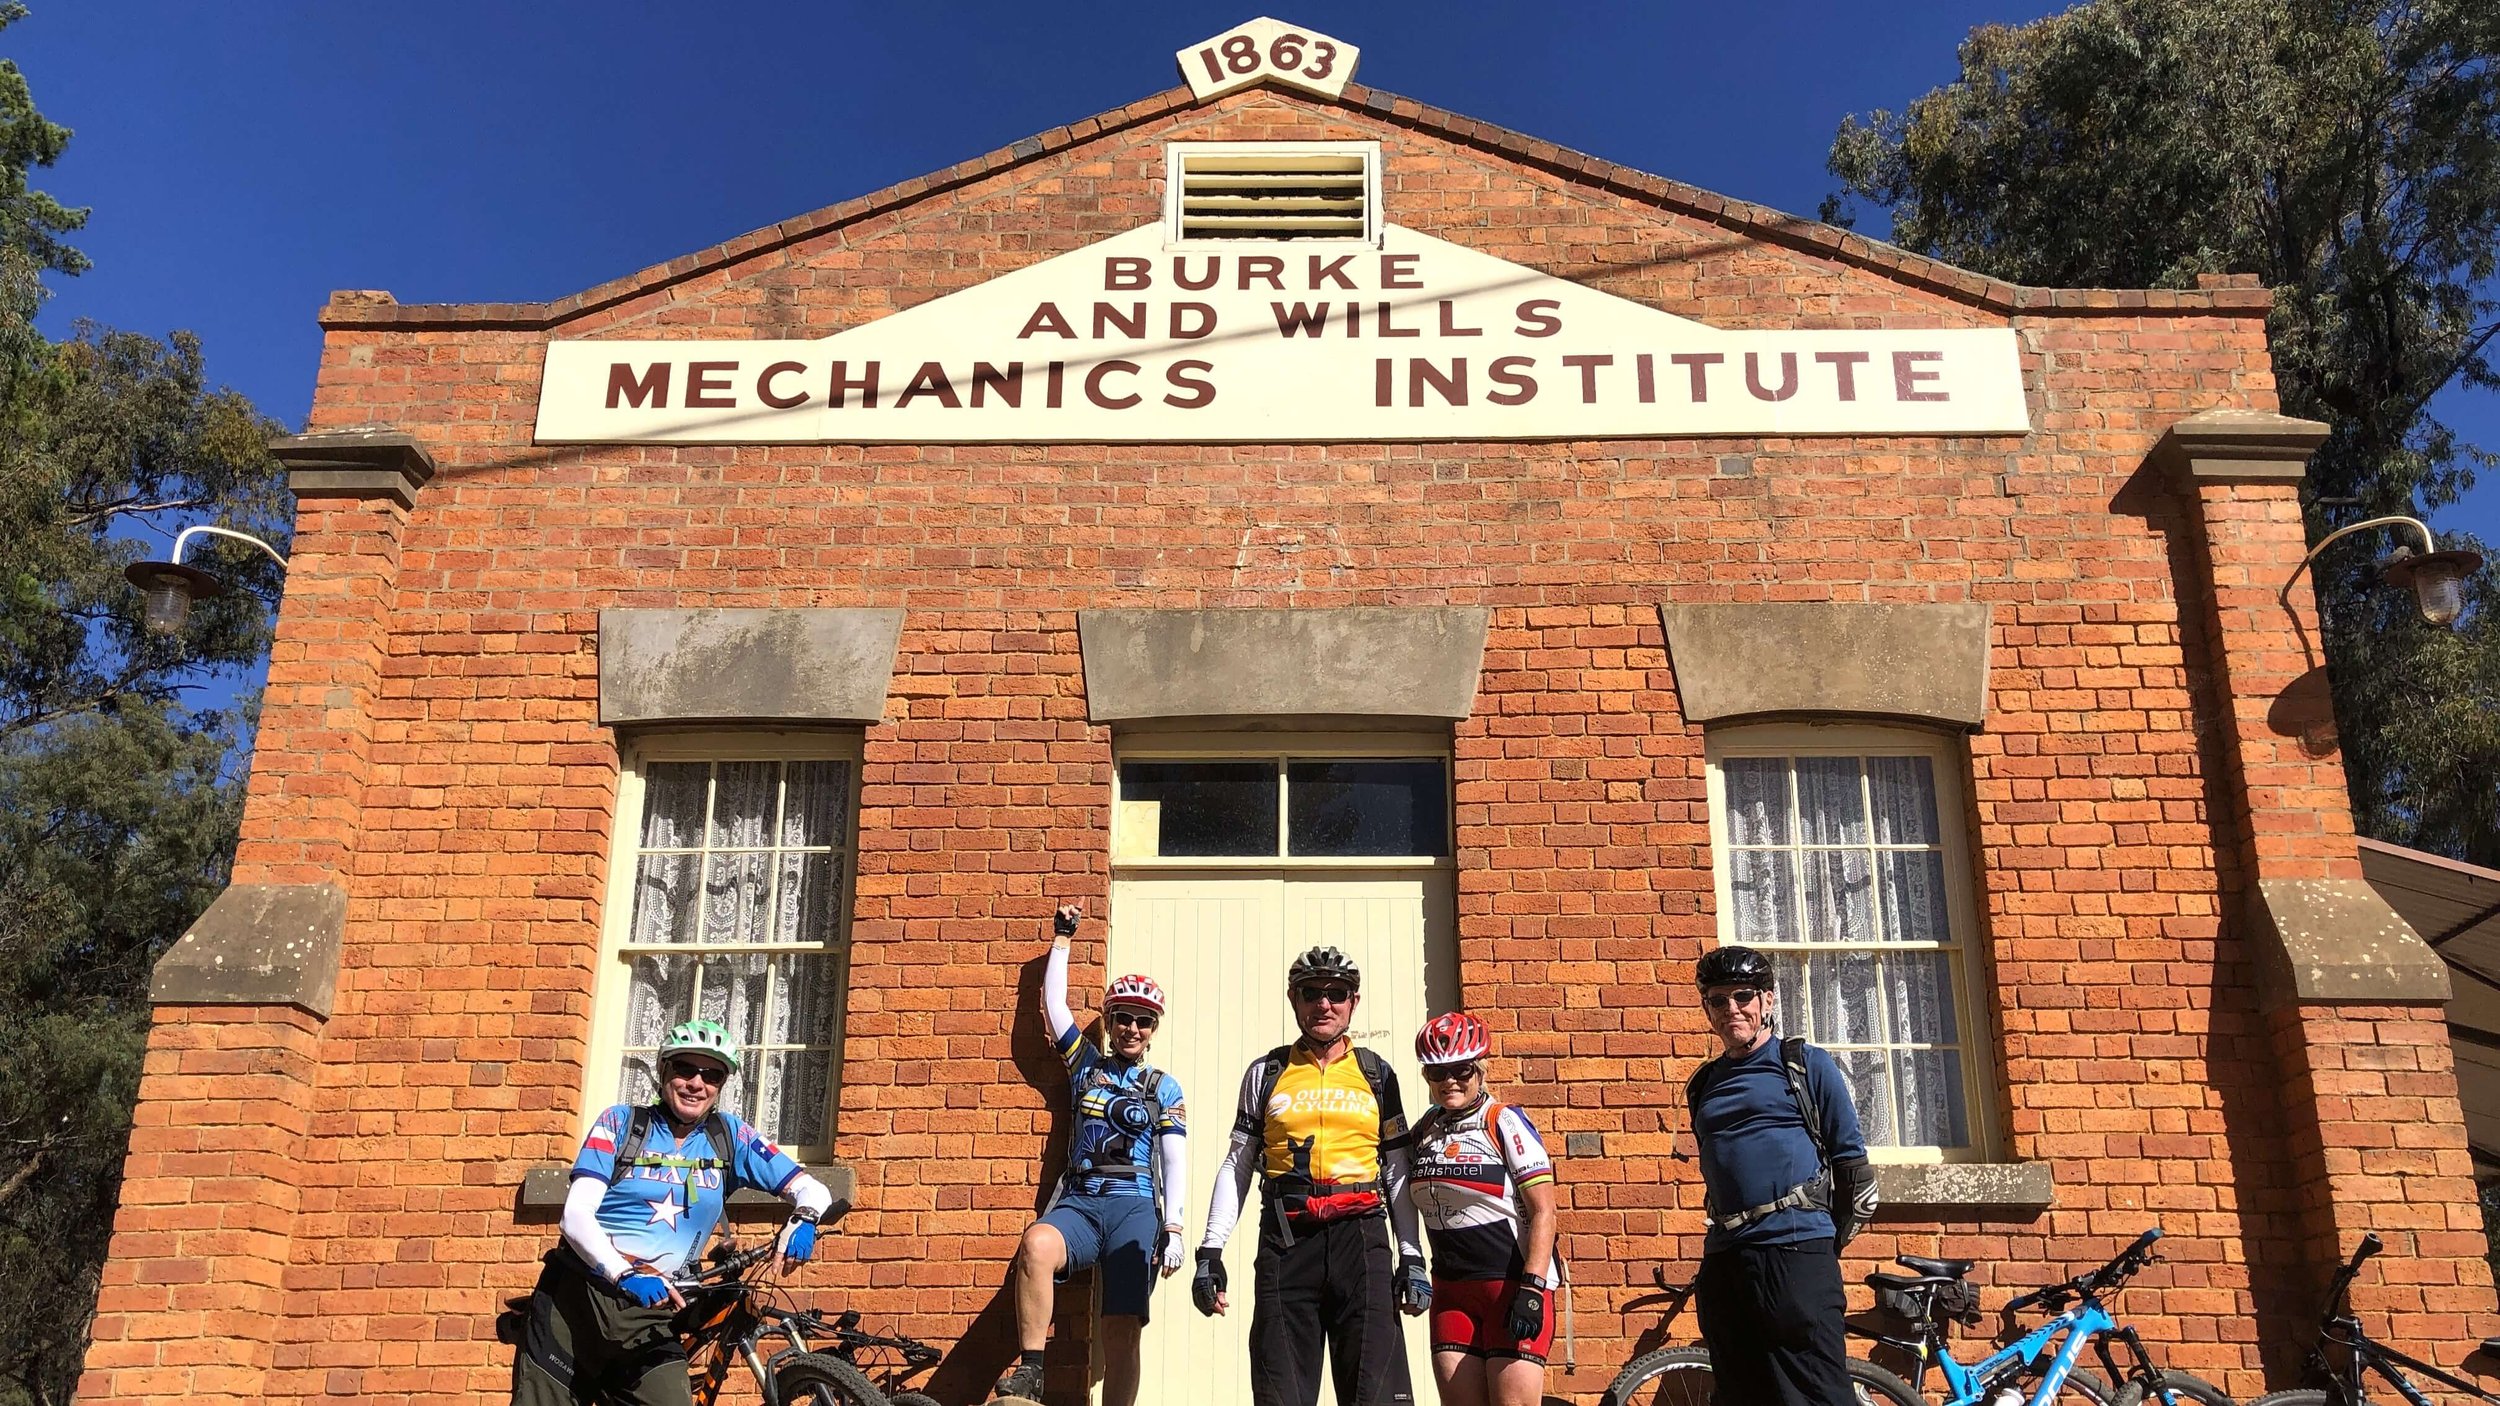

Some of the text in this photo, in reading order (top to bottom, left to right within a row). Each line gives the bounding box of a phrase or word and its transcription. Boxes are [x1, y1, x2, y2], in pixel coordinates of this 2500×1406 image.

[1199, 33, 1337, 84] 1863
[1104, 254, 1424, 291] BURKE
[1016, 299, 1562, 339] AND WILLS
[604, 351, 1950, 410] MECHANICS INSTITUTE
